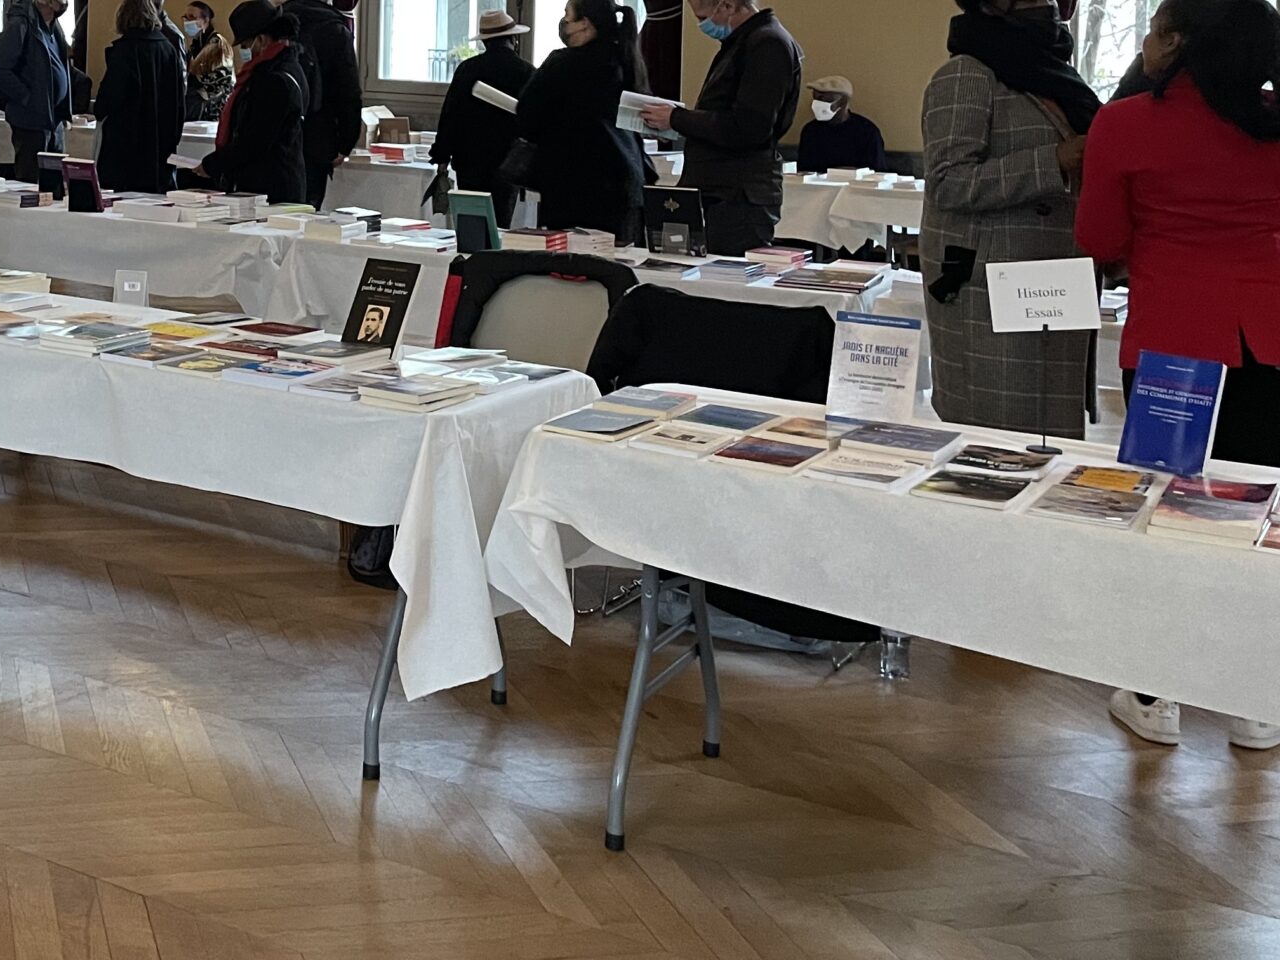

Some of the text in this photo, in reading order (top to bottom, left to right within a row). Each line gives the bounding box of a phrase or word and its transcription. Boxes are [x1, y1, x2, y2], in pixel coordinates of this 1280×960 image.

[1017, 285, 1066, 299] Histoire
[1025, 306, 1063, 319] Essais
[842, 341, 864, 352] JADIS
[864, 344, 873, 354] ET
[850, 353, 898, 367] DANS LA CITÉ
[1149, 391, 1187, 403] COMMUNES
